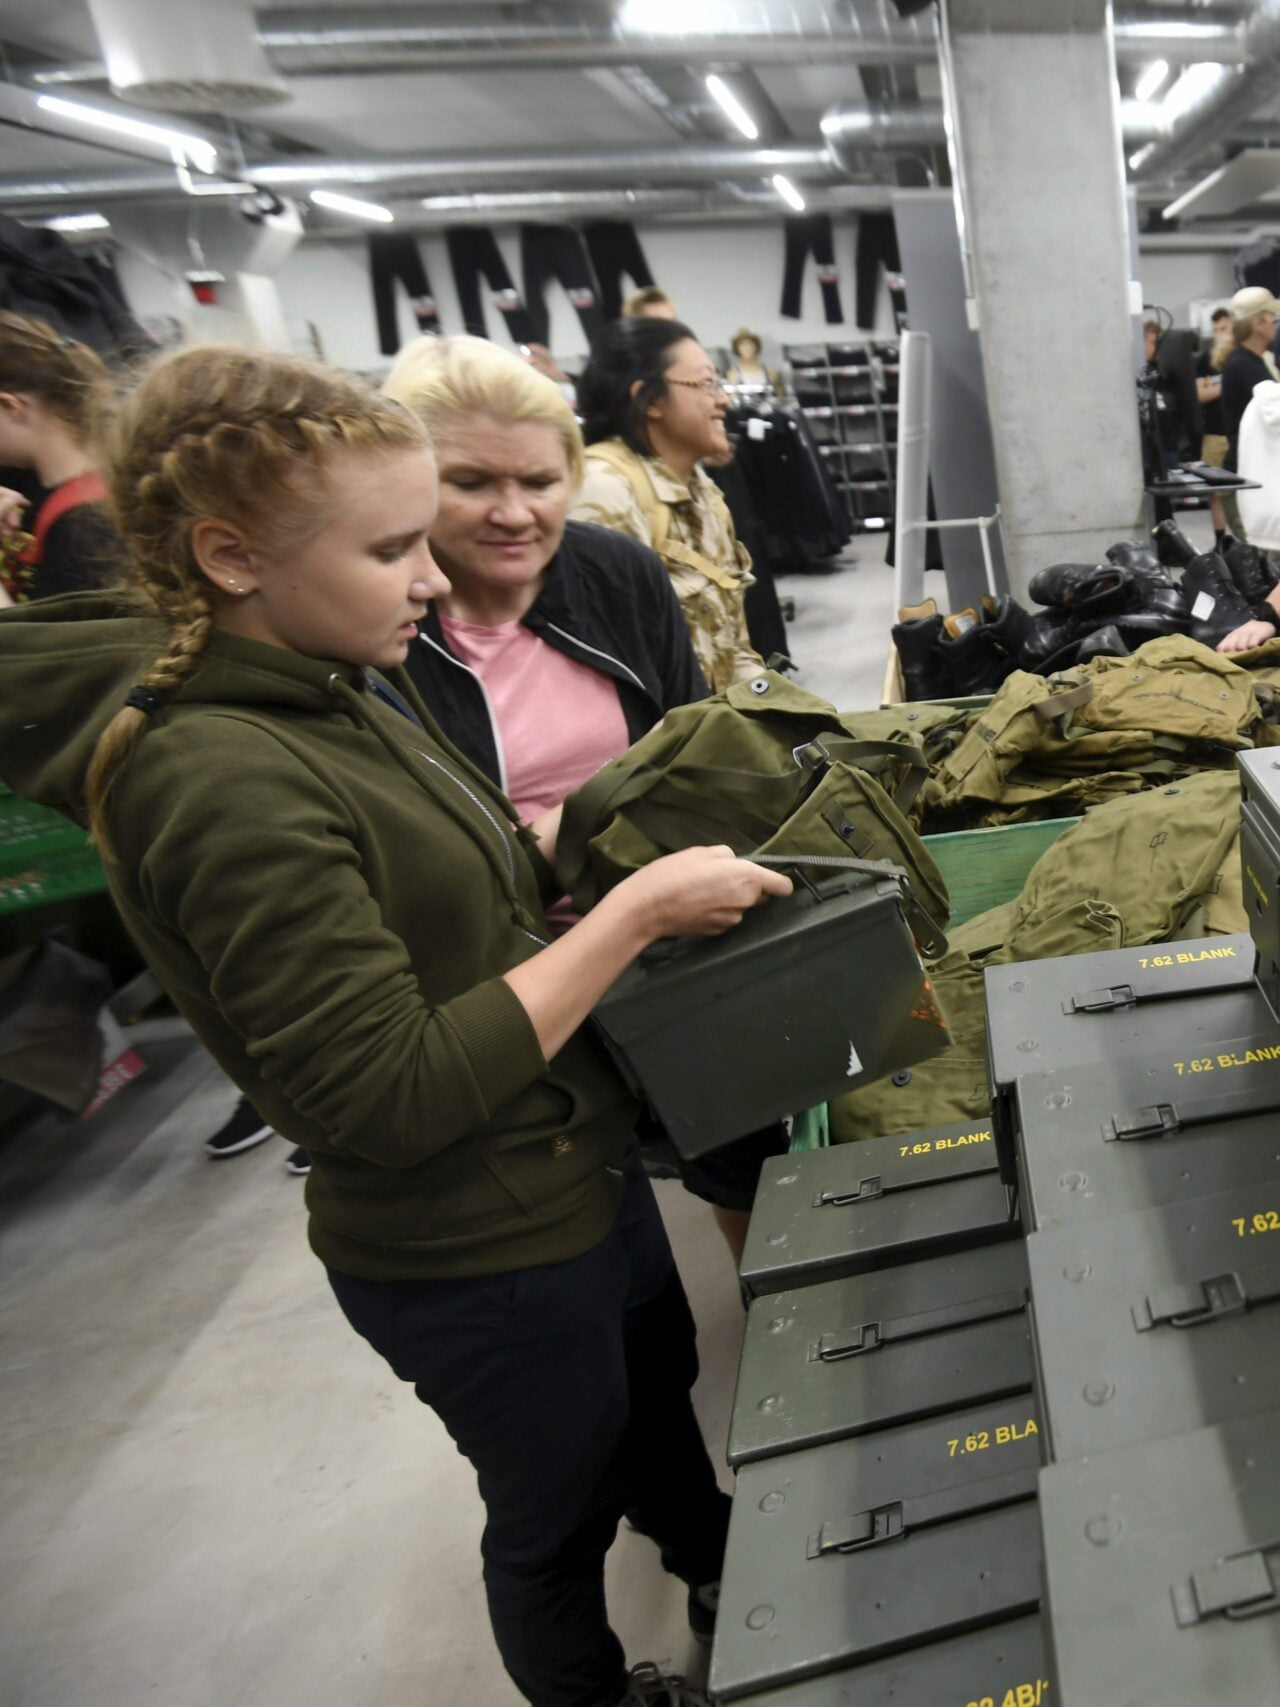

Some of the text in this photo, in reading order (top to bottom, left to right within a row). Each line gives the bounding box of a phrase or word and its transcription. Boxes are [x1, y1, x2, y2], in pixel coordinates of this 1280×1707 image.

[1139, 947, 1237, 969] 7.62 BLANK
[1173, 1058, 1214, 1076] 7.62
[899, 1131, 992, 1157] 7.62 BLANK
[946, 1419, 1039, 1457] 7.62 BLA
[1002, 1679, 1048, 1707] 4B/
